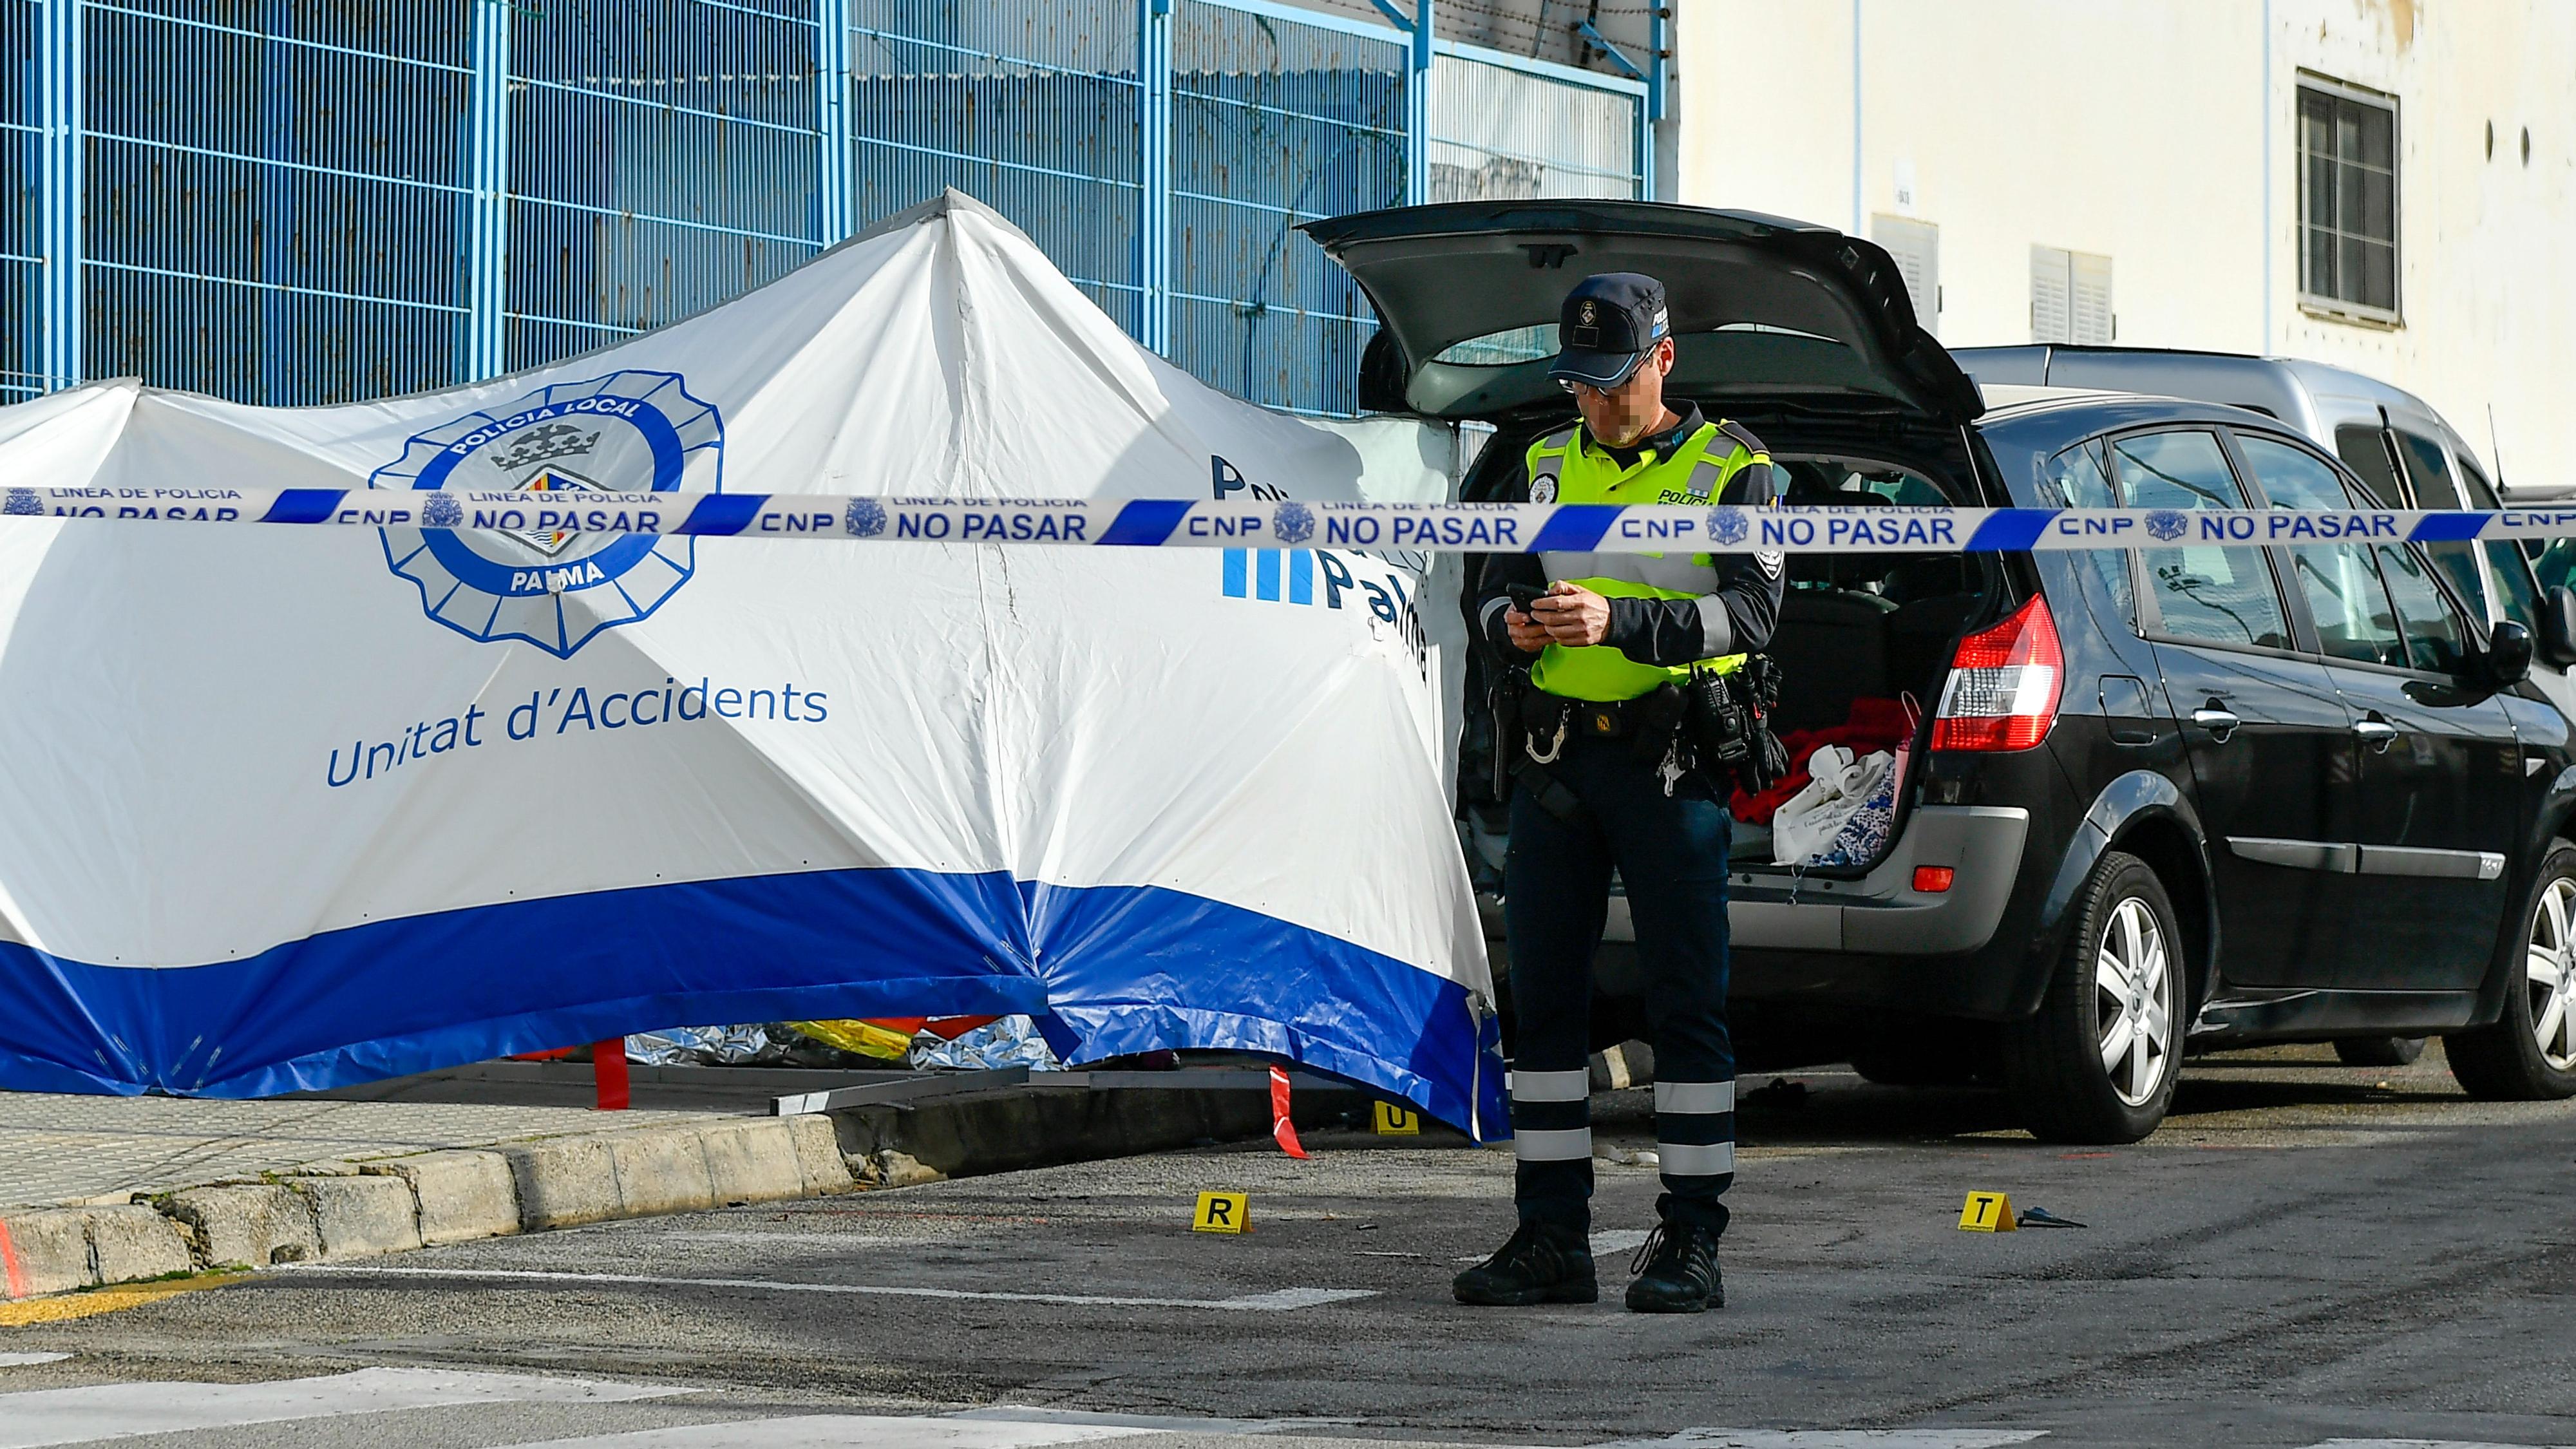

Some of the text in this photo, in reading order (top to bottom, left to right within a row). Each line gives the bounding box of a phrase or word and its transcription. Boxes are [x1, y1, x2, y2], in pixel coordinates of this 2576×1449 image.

[451, 399, 641, 455] POLICIA LOCAL
[50, 488, 242, 499] LINEA DE POLICIA
[469, 492, 663, 503] LINEA DE POLICIA
[893, 497, 1088, 507] LINEA DE POLICIA
[338, 509, 661, 533] CNP NO PASAR
[761, 512, 1087, 541] CNP NO PASAR
[1188, 516, 1519, 546] CNP NO PASAR
[1621, 518, 1956, 546] CNP NO PASAR
[2060, 515, 2398, 540] CNP NO PASAR
[2502, 513, 2576, 526] CNP
[326, 676, 829, 788] Unitat d'Accidents
[1387, 1106, 1406, 1128] U
[1207, 1198, 1233, 1225] R
[1976, 1197, 1994, 1224] T
